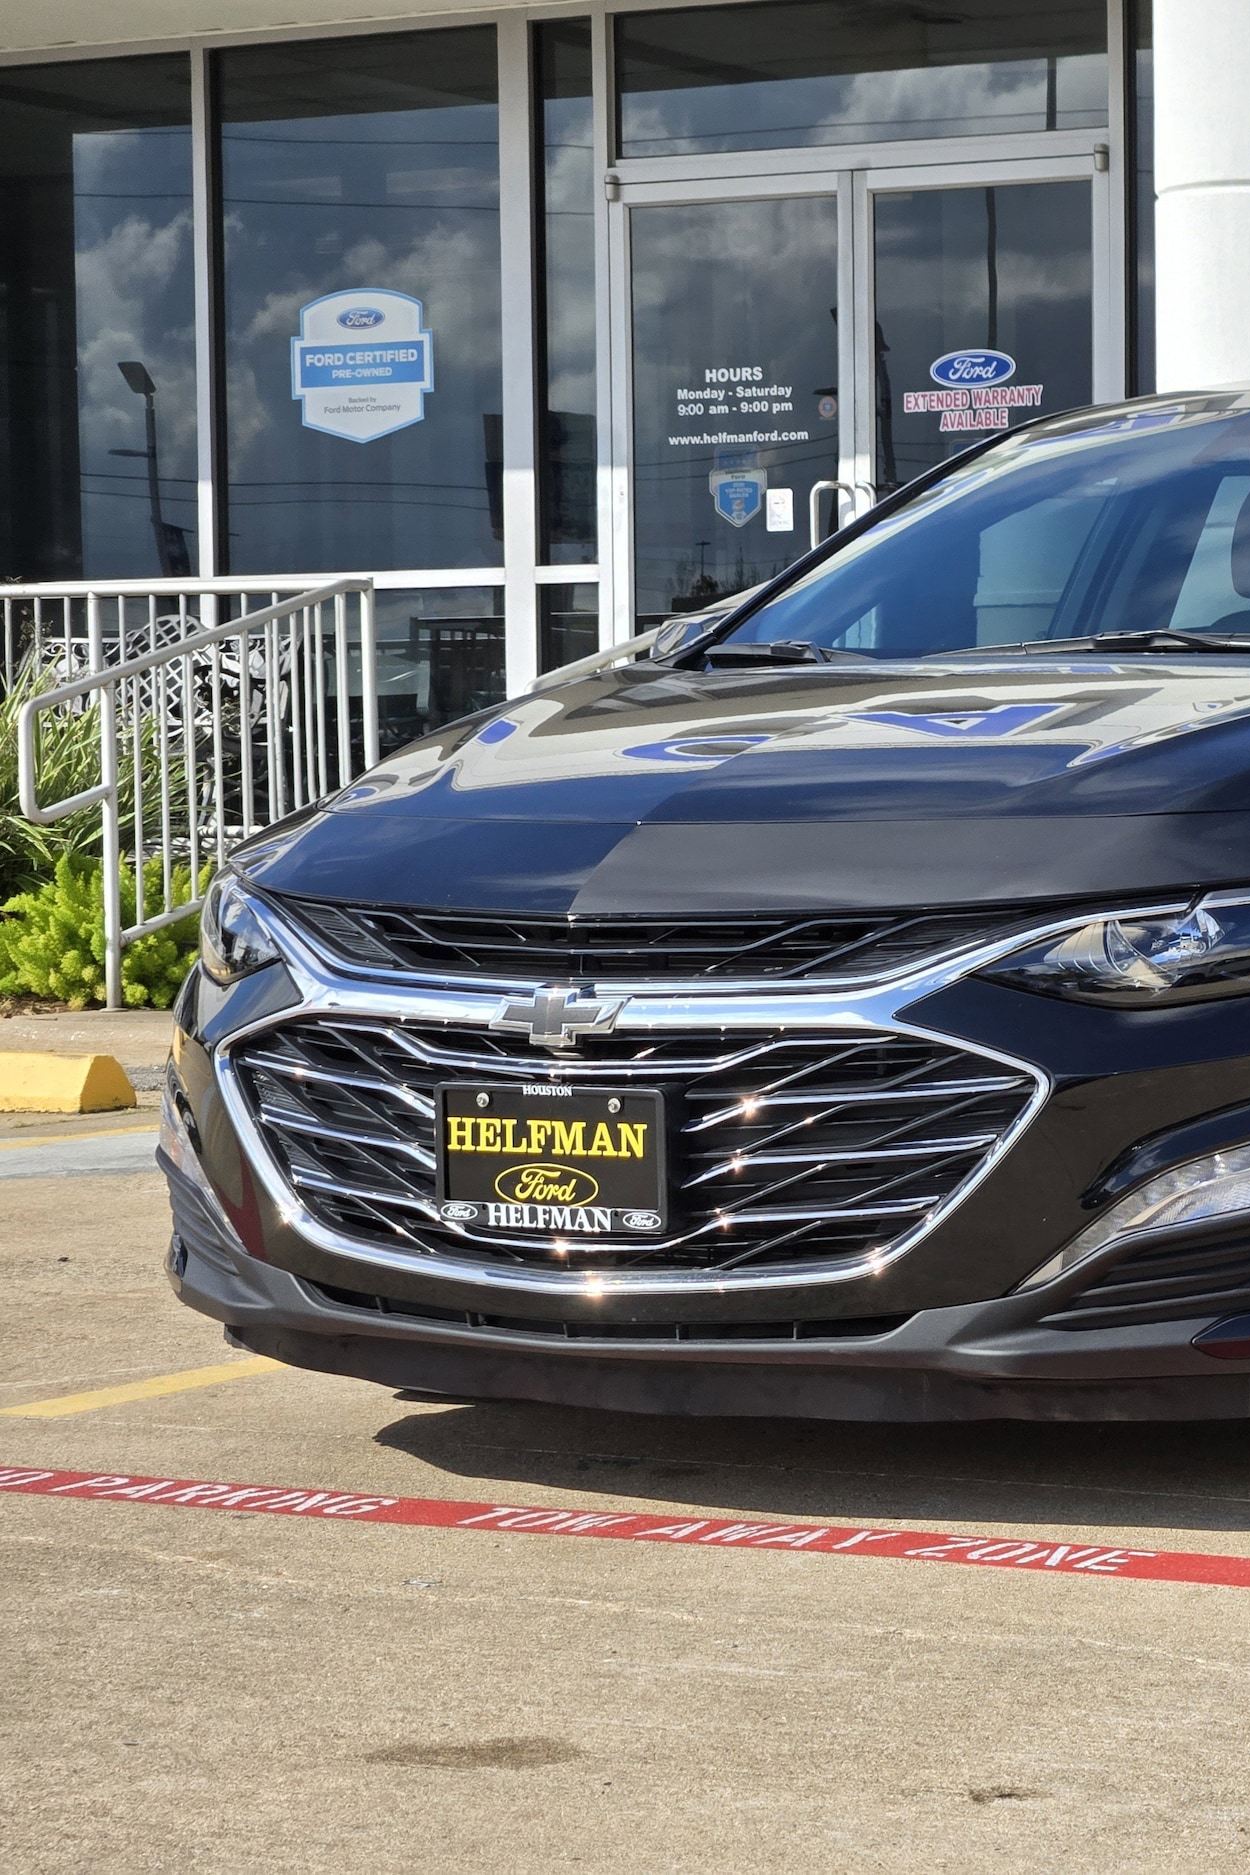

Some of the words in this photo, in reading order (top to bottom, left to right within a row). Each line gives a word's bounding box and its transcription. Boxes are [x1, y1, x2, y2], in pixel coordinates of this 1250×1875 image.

[305, 353, 344, 367] FORD
[346, 349, 418, 365] CERTIFIED
[332, 367, 393, 379] PRE-OWNED
[705, 366, 763, 383] HOURS
[948, 357, 998, 380] Ford
[677, 388, 725, 401] Monday
[736, 385, 793, 398] Saturday
[904, 390, 970, 413] EXTENDED
[972, 384, 1043, 408] WARRANTY
[324, 406, 341, 414] Ford
[342, 405, 364, 413] Motor
[365, 404, 401, 412] Company
[677, 403, 704, 416] 9:00
[708, 404, 729, 414] am
[740, 401, 769, 413] 9:00
[772, 401, 793, 414] pm
[940, 408, 1008, 432] AVAILABLE
[669, 430, 809, 445] www.helfmanford.com
[522, 1084, 573, 1097] HOUSTON
[446, 1116, 648, 1158] HELFMAN
[515, 1168, 577, 1202] Ford
[487, 1202, 612, 1232] HELFMAN
[48, 1475, 400, 1516] PARKING
[457, 1507, 638, 1532] TOW
[633, 1520, 899, 1550] AWAY
[904, 1536, 1158, 1572] ZONE
